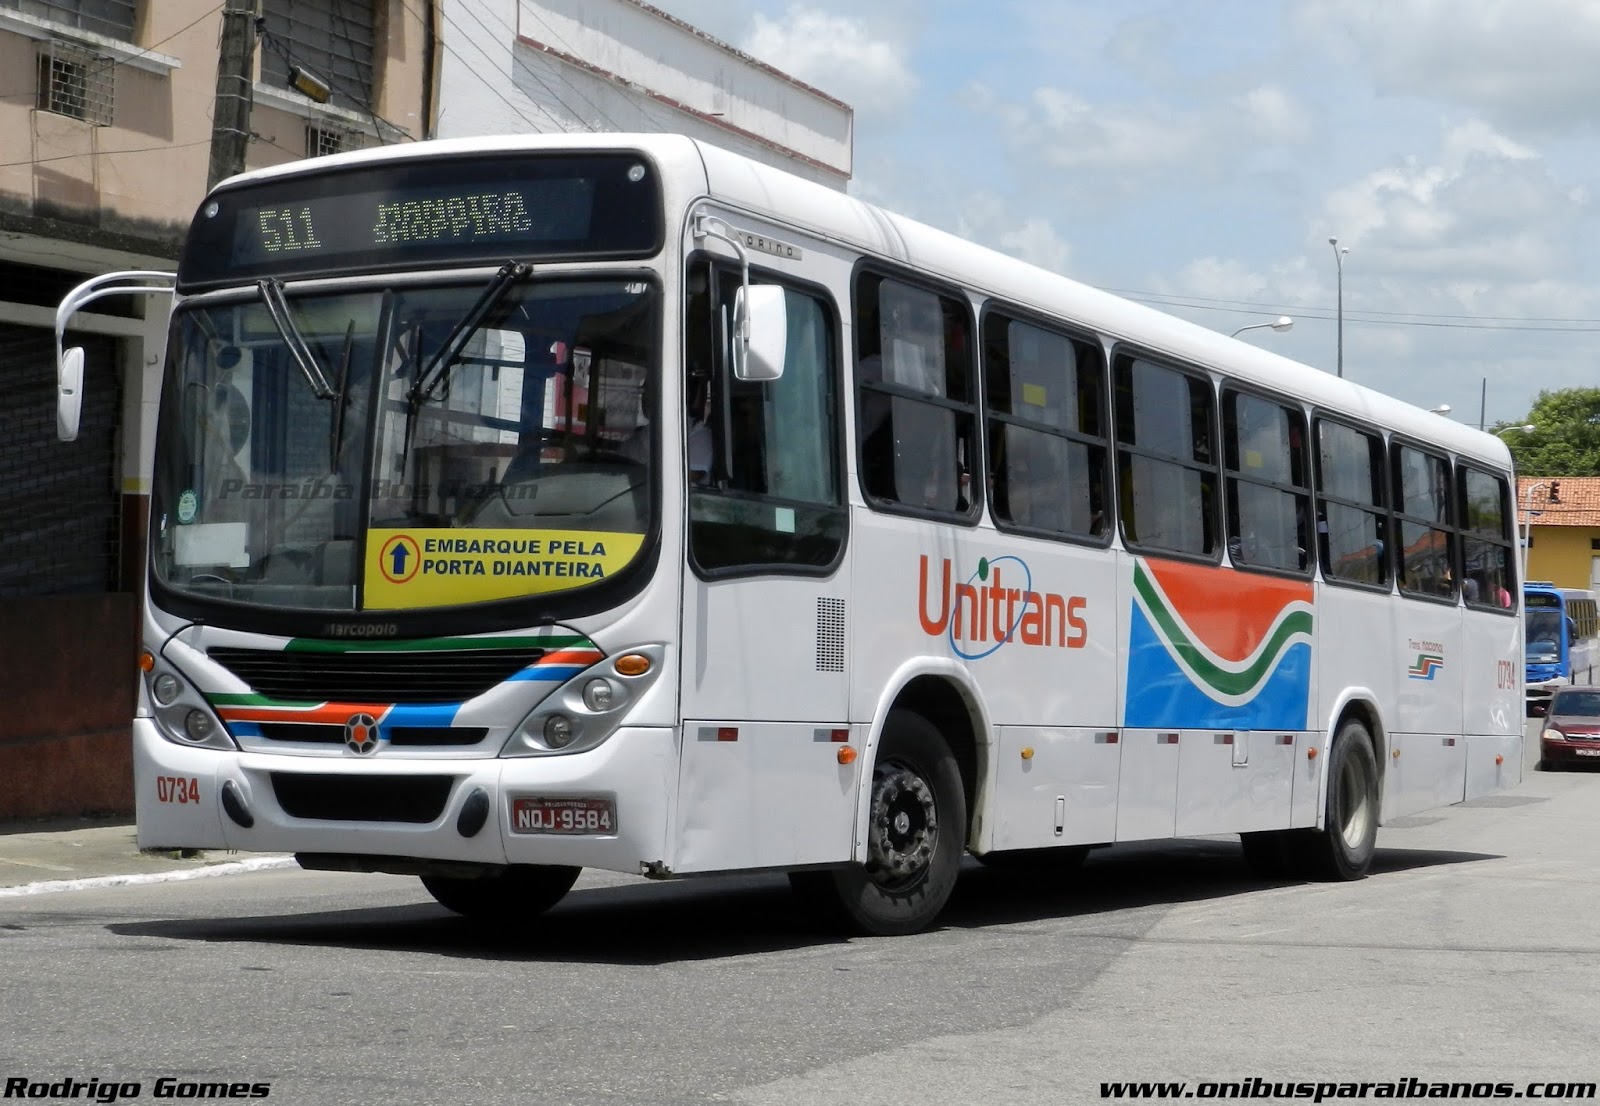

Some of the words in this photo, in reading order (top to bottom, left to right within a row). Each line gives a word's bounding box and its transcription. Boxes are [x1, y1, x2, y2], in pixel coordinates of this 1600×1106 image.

[259, 207, 321, 251] 511
[373, 212, 532, 242] SHOPPING
[740, 234, 793, 256] ORINO
[424, 539, 541, 554] EMBARQUE
[549, 540, 606, 556] PELA
[423, 559, 486, 575] PORTA
[493, 561, 605, 577] DIANTEIRA
[918, 554, 1087, 648] Unitrans
[1498, 660, 1515, 690] 0734
[157, 776, 200, 804] 0734
